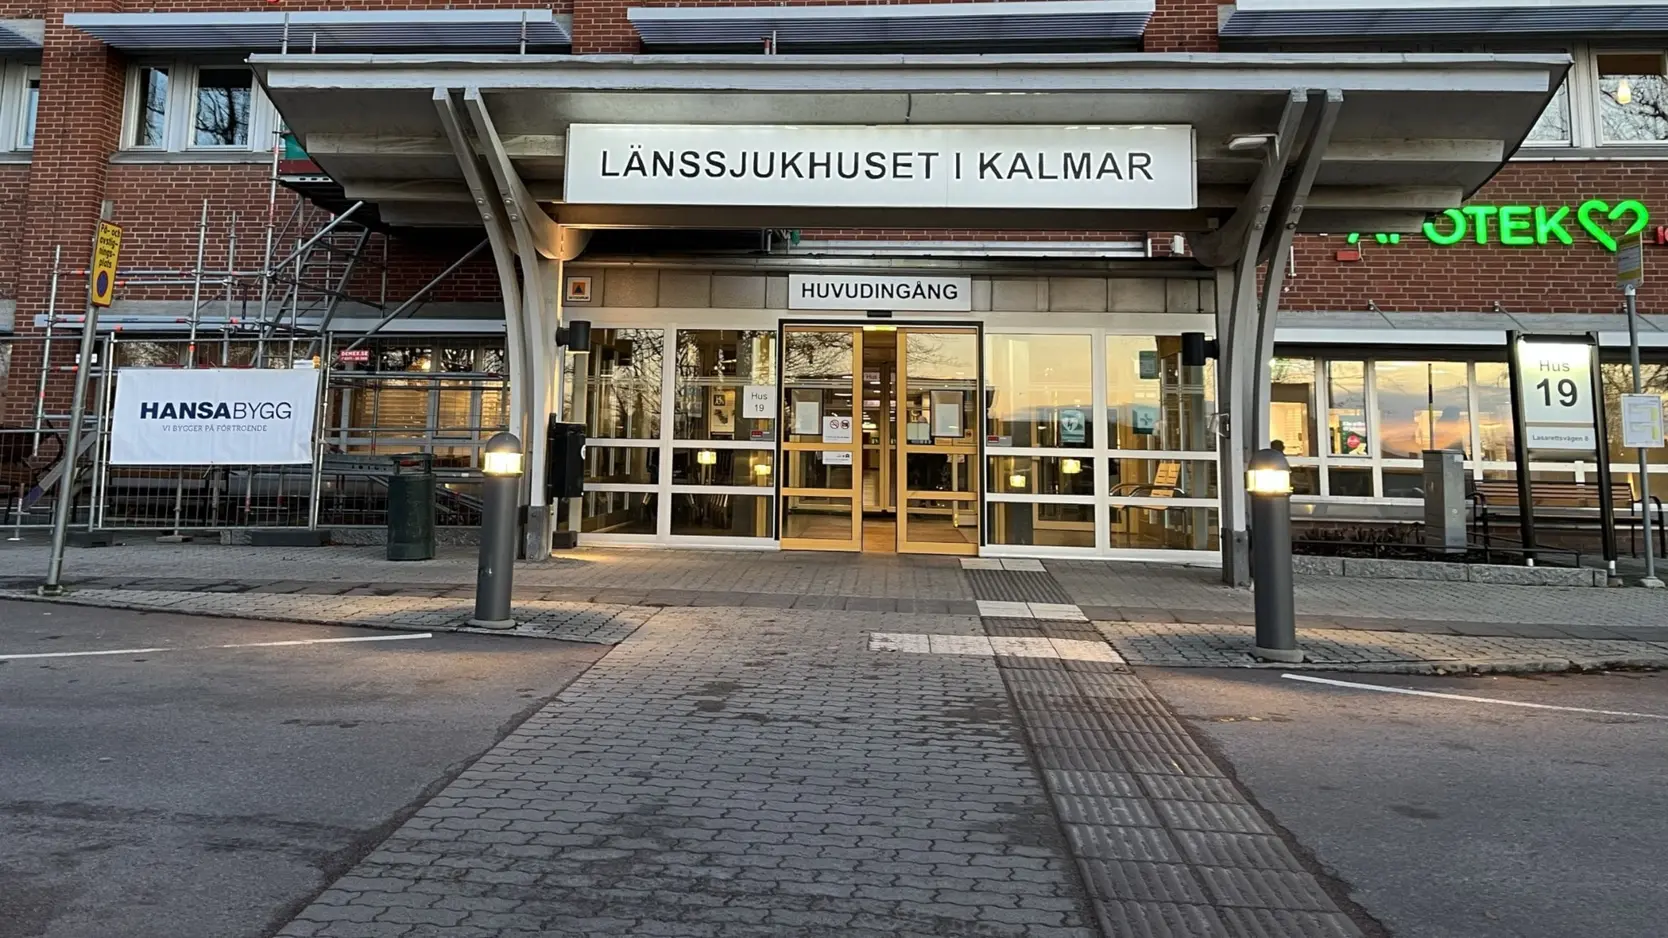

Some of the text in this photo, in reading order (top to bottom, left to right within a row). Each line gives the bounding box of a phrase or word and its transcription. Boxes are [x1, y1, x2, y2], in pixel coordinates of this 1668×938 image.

[600, 144, 1154, 180] LÄNSSJUKHUSET I KALMAR
[1347, 205, 1573, 245] OTEK
[111, 229, 120, 237] och
[99, 258, 112, 268] plats
[802, 281, 958, 299] HUVUDINGÅNG
[1539, 359, 1570, 372] Hus
[751, 392, 768, 400] Hus
[1536, 378, 1578, 407] 19
[754, 404, 765, 412] 19
[162, 424, 267, 432] VI BYGGER PÅ FÖRTROENDE
[1532, 434, 1583, 443] Lasarettsvägen
